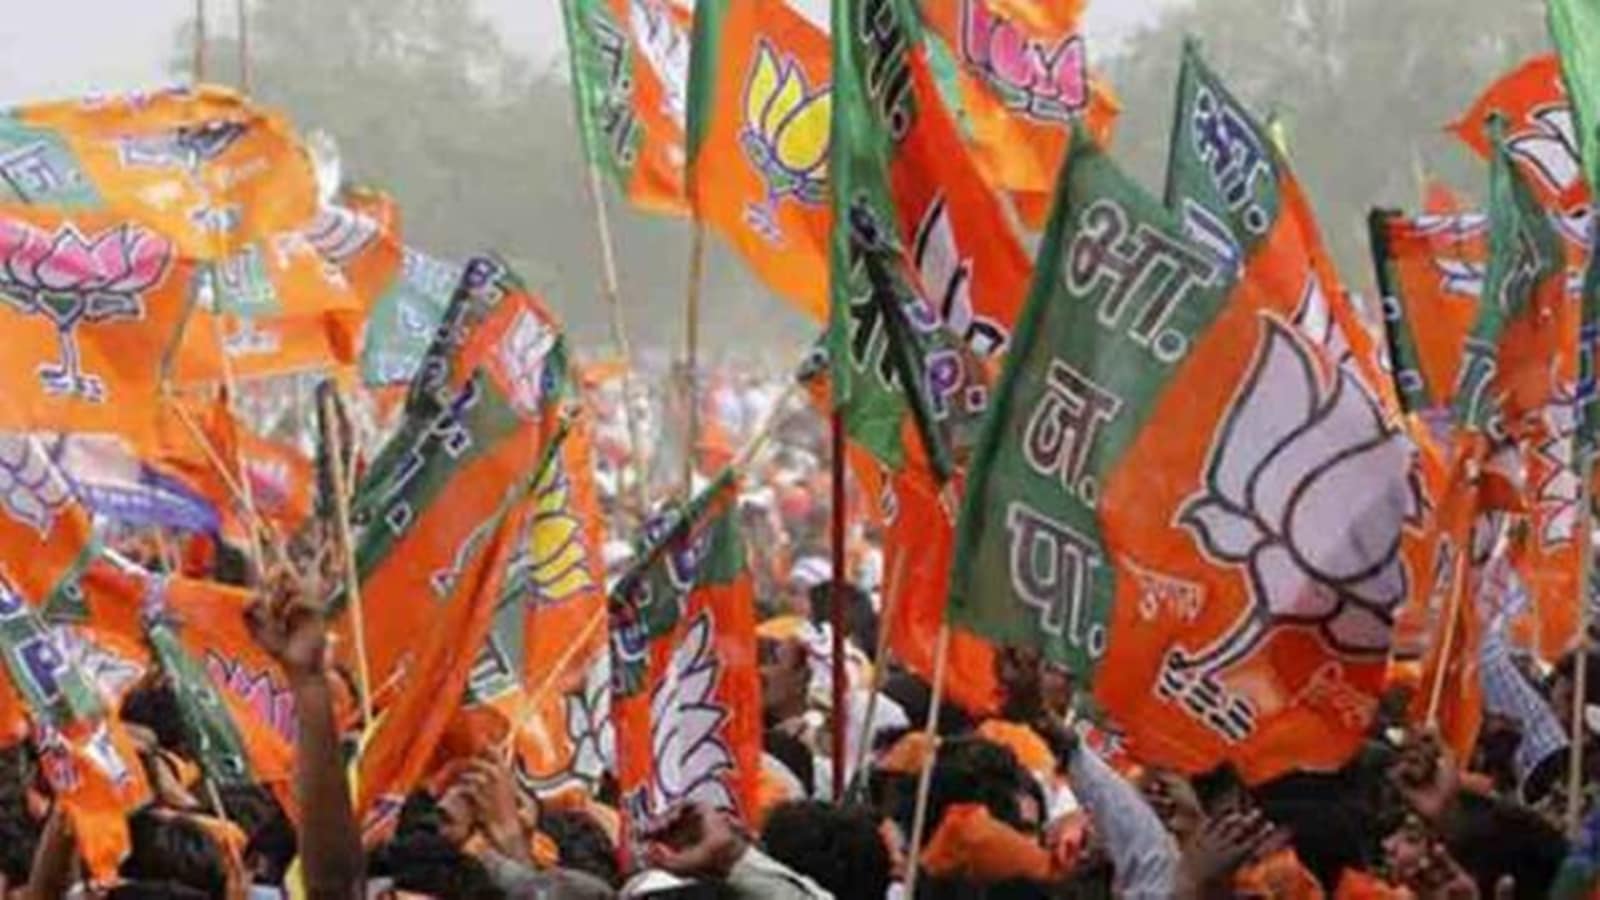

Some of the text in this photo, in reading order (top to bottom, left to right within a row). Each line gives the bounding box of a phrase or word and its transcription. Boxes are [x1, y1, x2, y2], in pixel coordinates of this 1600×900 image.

[1065, 200, 1218, 362] भा.
[1023, 358, 1125, 509] ज.
[1006, 499, 1109, 658] पा.
